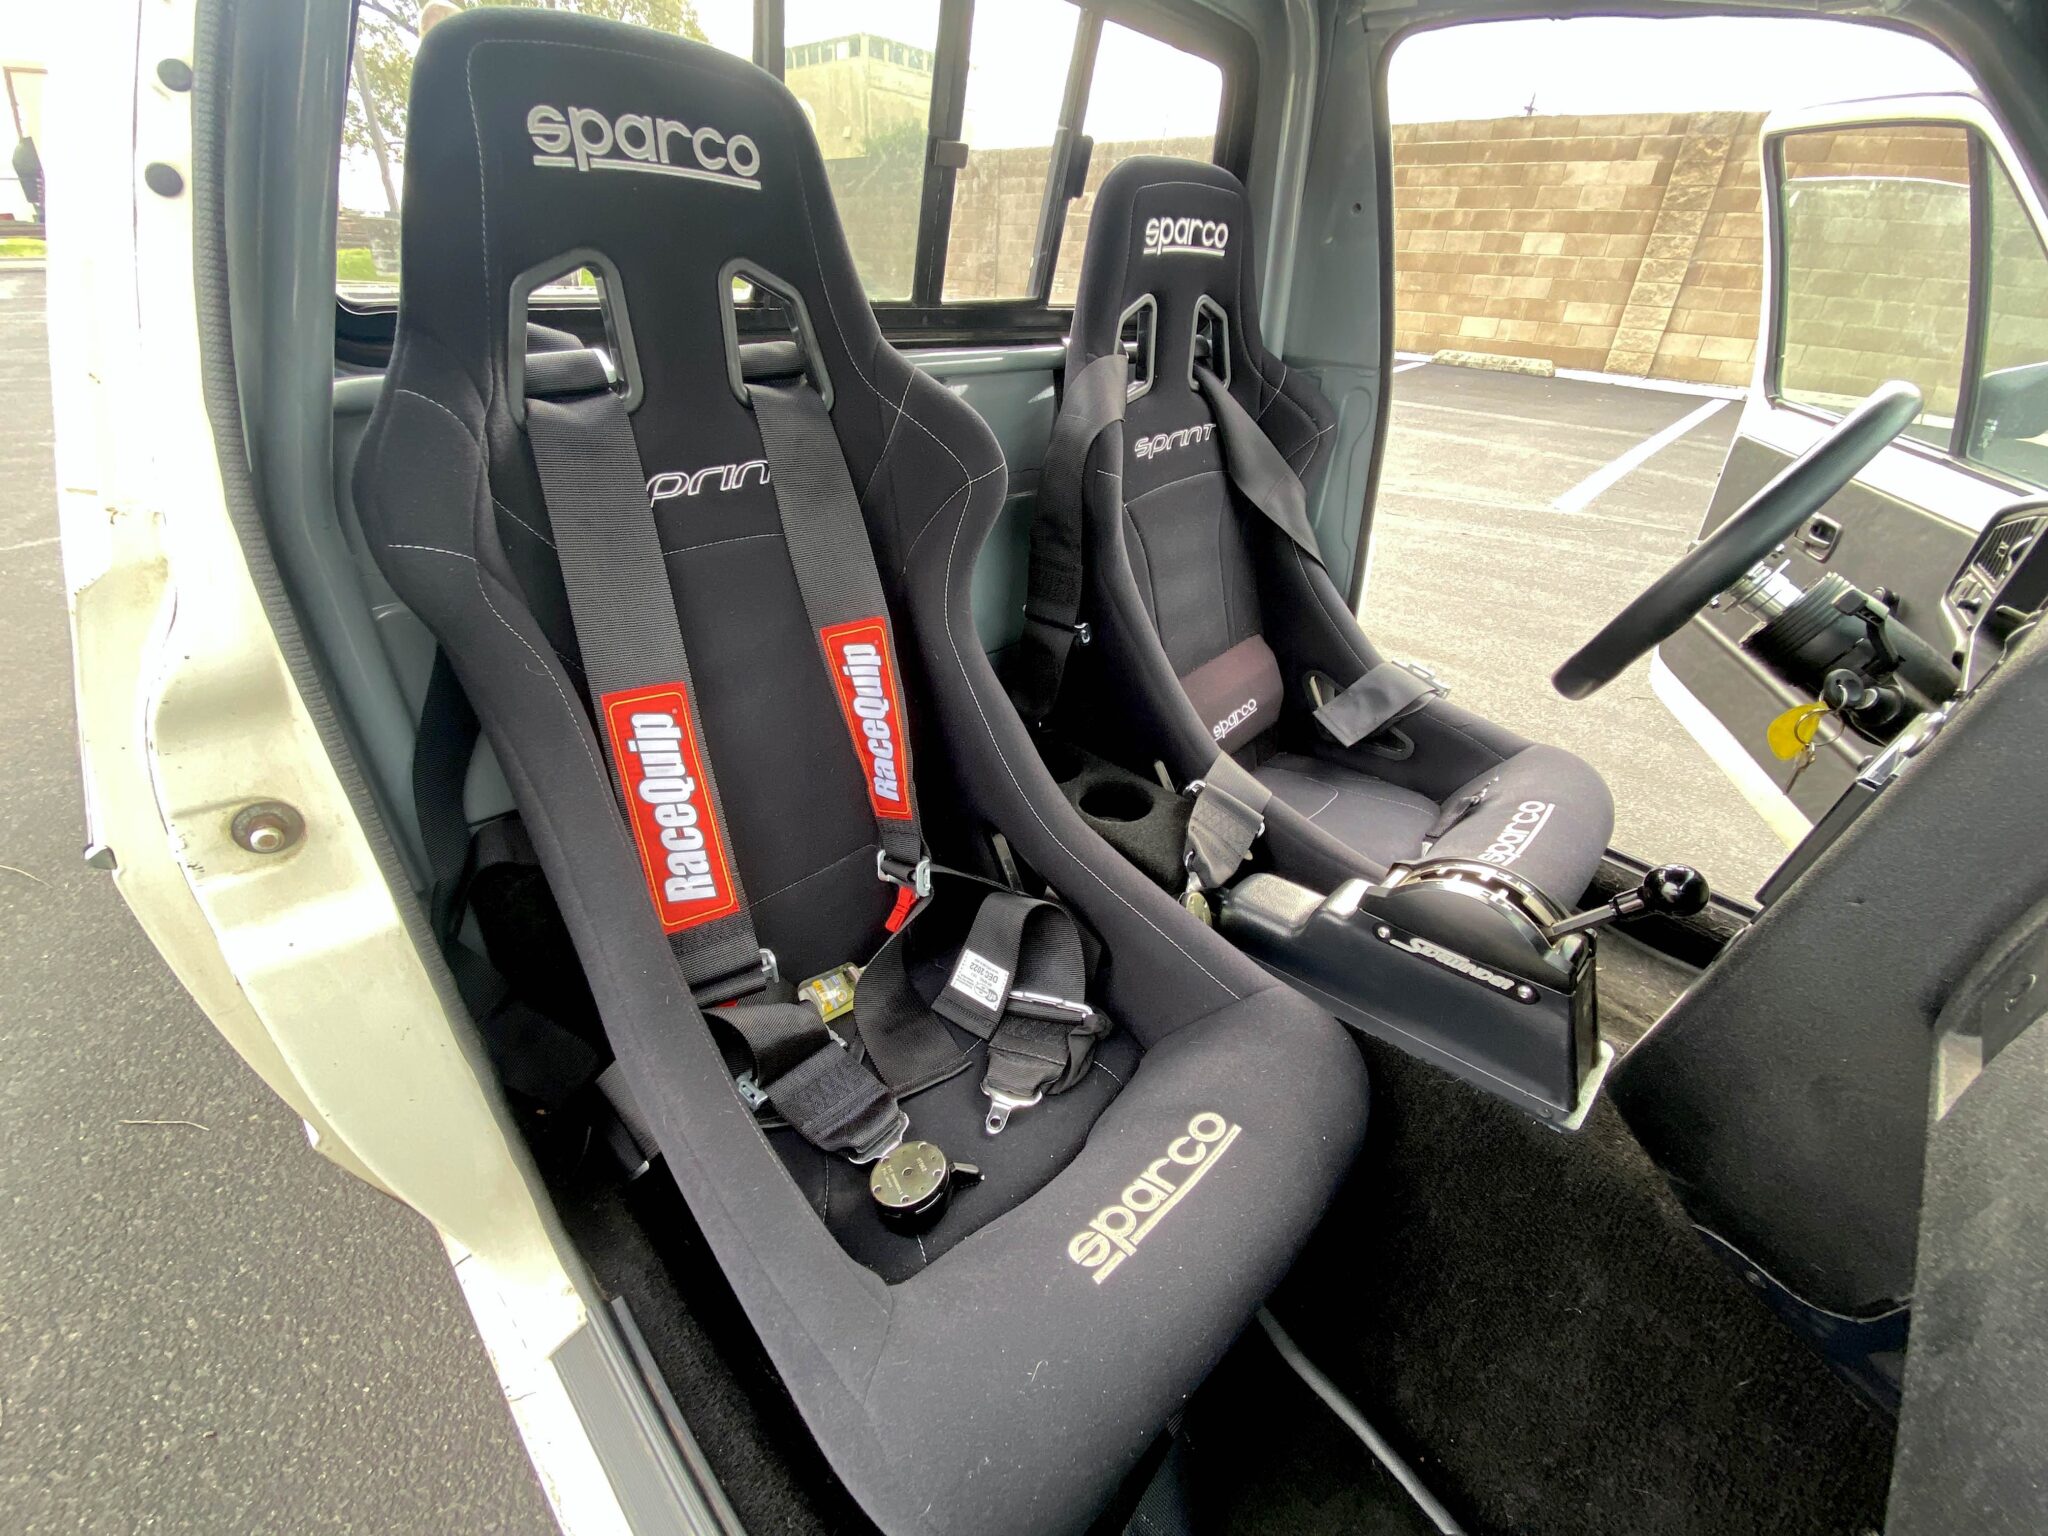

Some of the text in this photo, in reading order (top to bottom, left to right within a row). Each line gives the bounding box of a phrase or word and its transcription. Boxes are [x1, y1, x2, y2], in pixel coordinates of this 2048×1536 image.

[527, 105, 761, 180] sparco
[1144, 216, 1229, 256] sparco
[646, 460, 771, 508] prin
[842, 643, 901, 802] RaceQuip
[1213, 698, 1257, 739] sparco
[627, 712, 717, 902] RaceQuip
[1478, 800, 1550, 866] sparco
[1068, 1112, 1232, 1272] sparco
